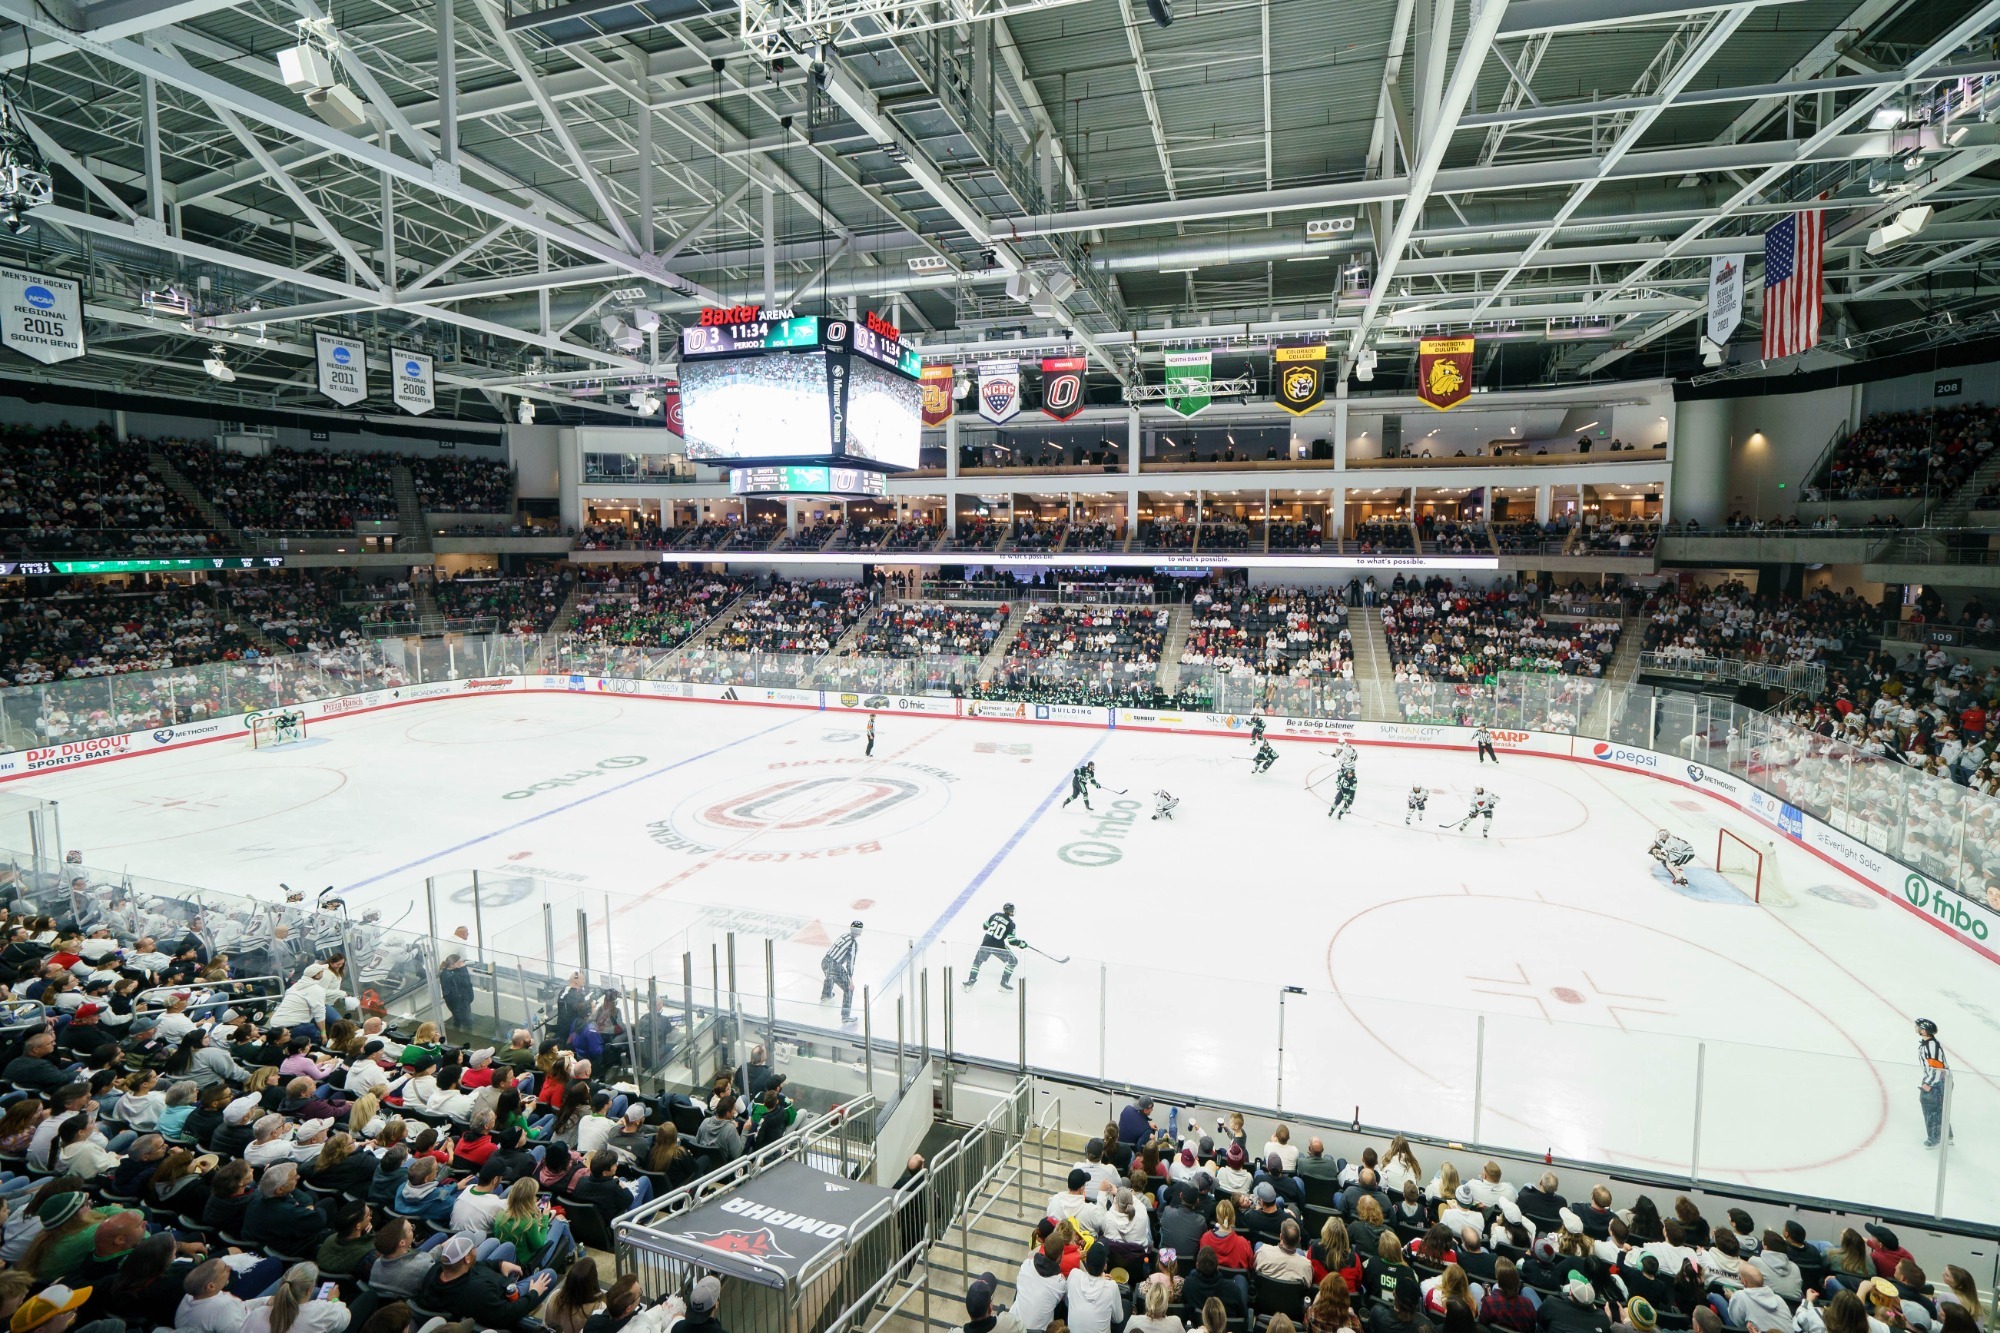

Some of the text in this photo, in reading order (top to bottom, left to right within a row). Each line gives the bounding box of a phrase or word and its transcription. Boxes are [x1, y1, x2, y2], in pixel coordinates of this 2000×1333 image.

[2, 270, 73, 290] MEN'S ICE HOCKEY
[27, 294, 55, 305] NCAA
[14, 305, 68, 321] REGIONAL
[701, 305, 795, 327] Baxter ARENA
[24, 317, 64, 337] 2015
[731, 322, 769, 339] 11:34
[780, 320, 790, 338] 1
[867, 311, 915, 352] Baxter ARENA
[11, 333, 78, 349] SOUTH BEND
[711, 327, 720, 344] 3
[869, 332, 876, 349] 3
[734, 339, 766, 350] PERIOD 2
[881, 338, 900, 358] 11:34
[905, 351, 910, 366] 1
[326, 362, 358, 373] REGIONAL
[331, 371, 355, 385] 2011
[400, 376, 427, 385] REGIONAL
[339, 386, 359, 394] LOUIS
[403, 383, 426, 396] 2006
[982, 384, 1016, 397] NCHC
[1937, 383, 1958, 393] 208
[398, 395, 431, 404] WORCESTER
[834, 413, 844, 443] Omaha
[313, 432, 327, 440] 223
[1201, 556, 1231, 564] possible.
[1366, 558, 1391, 566] what's
[1393, 559, 1427, 567] possible.
[21, 566, 50, 574] 11:34
[66, 563, 73, 573] 1
[1932, 632, 1953, 642] 109
[411, 687, 451, 698] BROADMOOR
[652, 682, 679, 692] Velocity
[777, 693, 796, 701] Google
[323, 697, 363, 713] Pizza Ranch
[910, 700, 926, 710] fnic
[1051, 707, 1092, 715] BUILDING
[175, 725, 220, 738] METHODIST
[1286, 719, 1296, 727] Be
[1304, 720, 1323, 729] 6a-6p
[1324, 721, 1355, 730] Listener
[1380, 726, 1398, 734] SUN
[1420, 728, 1442, 736] CITY
[26, 734, 132, 763] DJ's DUGOUT
[28, 754, 81, 770] SPORTS
[85, 750, 111, 761] BAR
[1616, 750, 1658, 767] pepsi
[767, 757, 962, 784] Baxter ARENA
[1703, 775, 1737, 793] METHODIST
[1079, 800, 1143, 839] fnbo
[646, 819, 883, 864] ARENA Baxter
[1824, 834, 1859, 862] Everlight
[1859, 853, 1882, 873] Solar
[1932, 889, 1989, 941] fnbo
[986, 920, 1007, 940] 20
[720, 1196, 849, 1240] OMAHA
